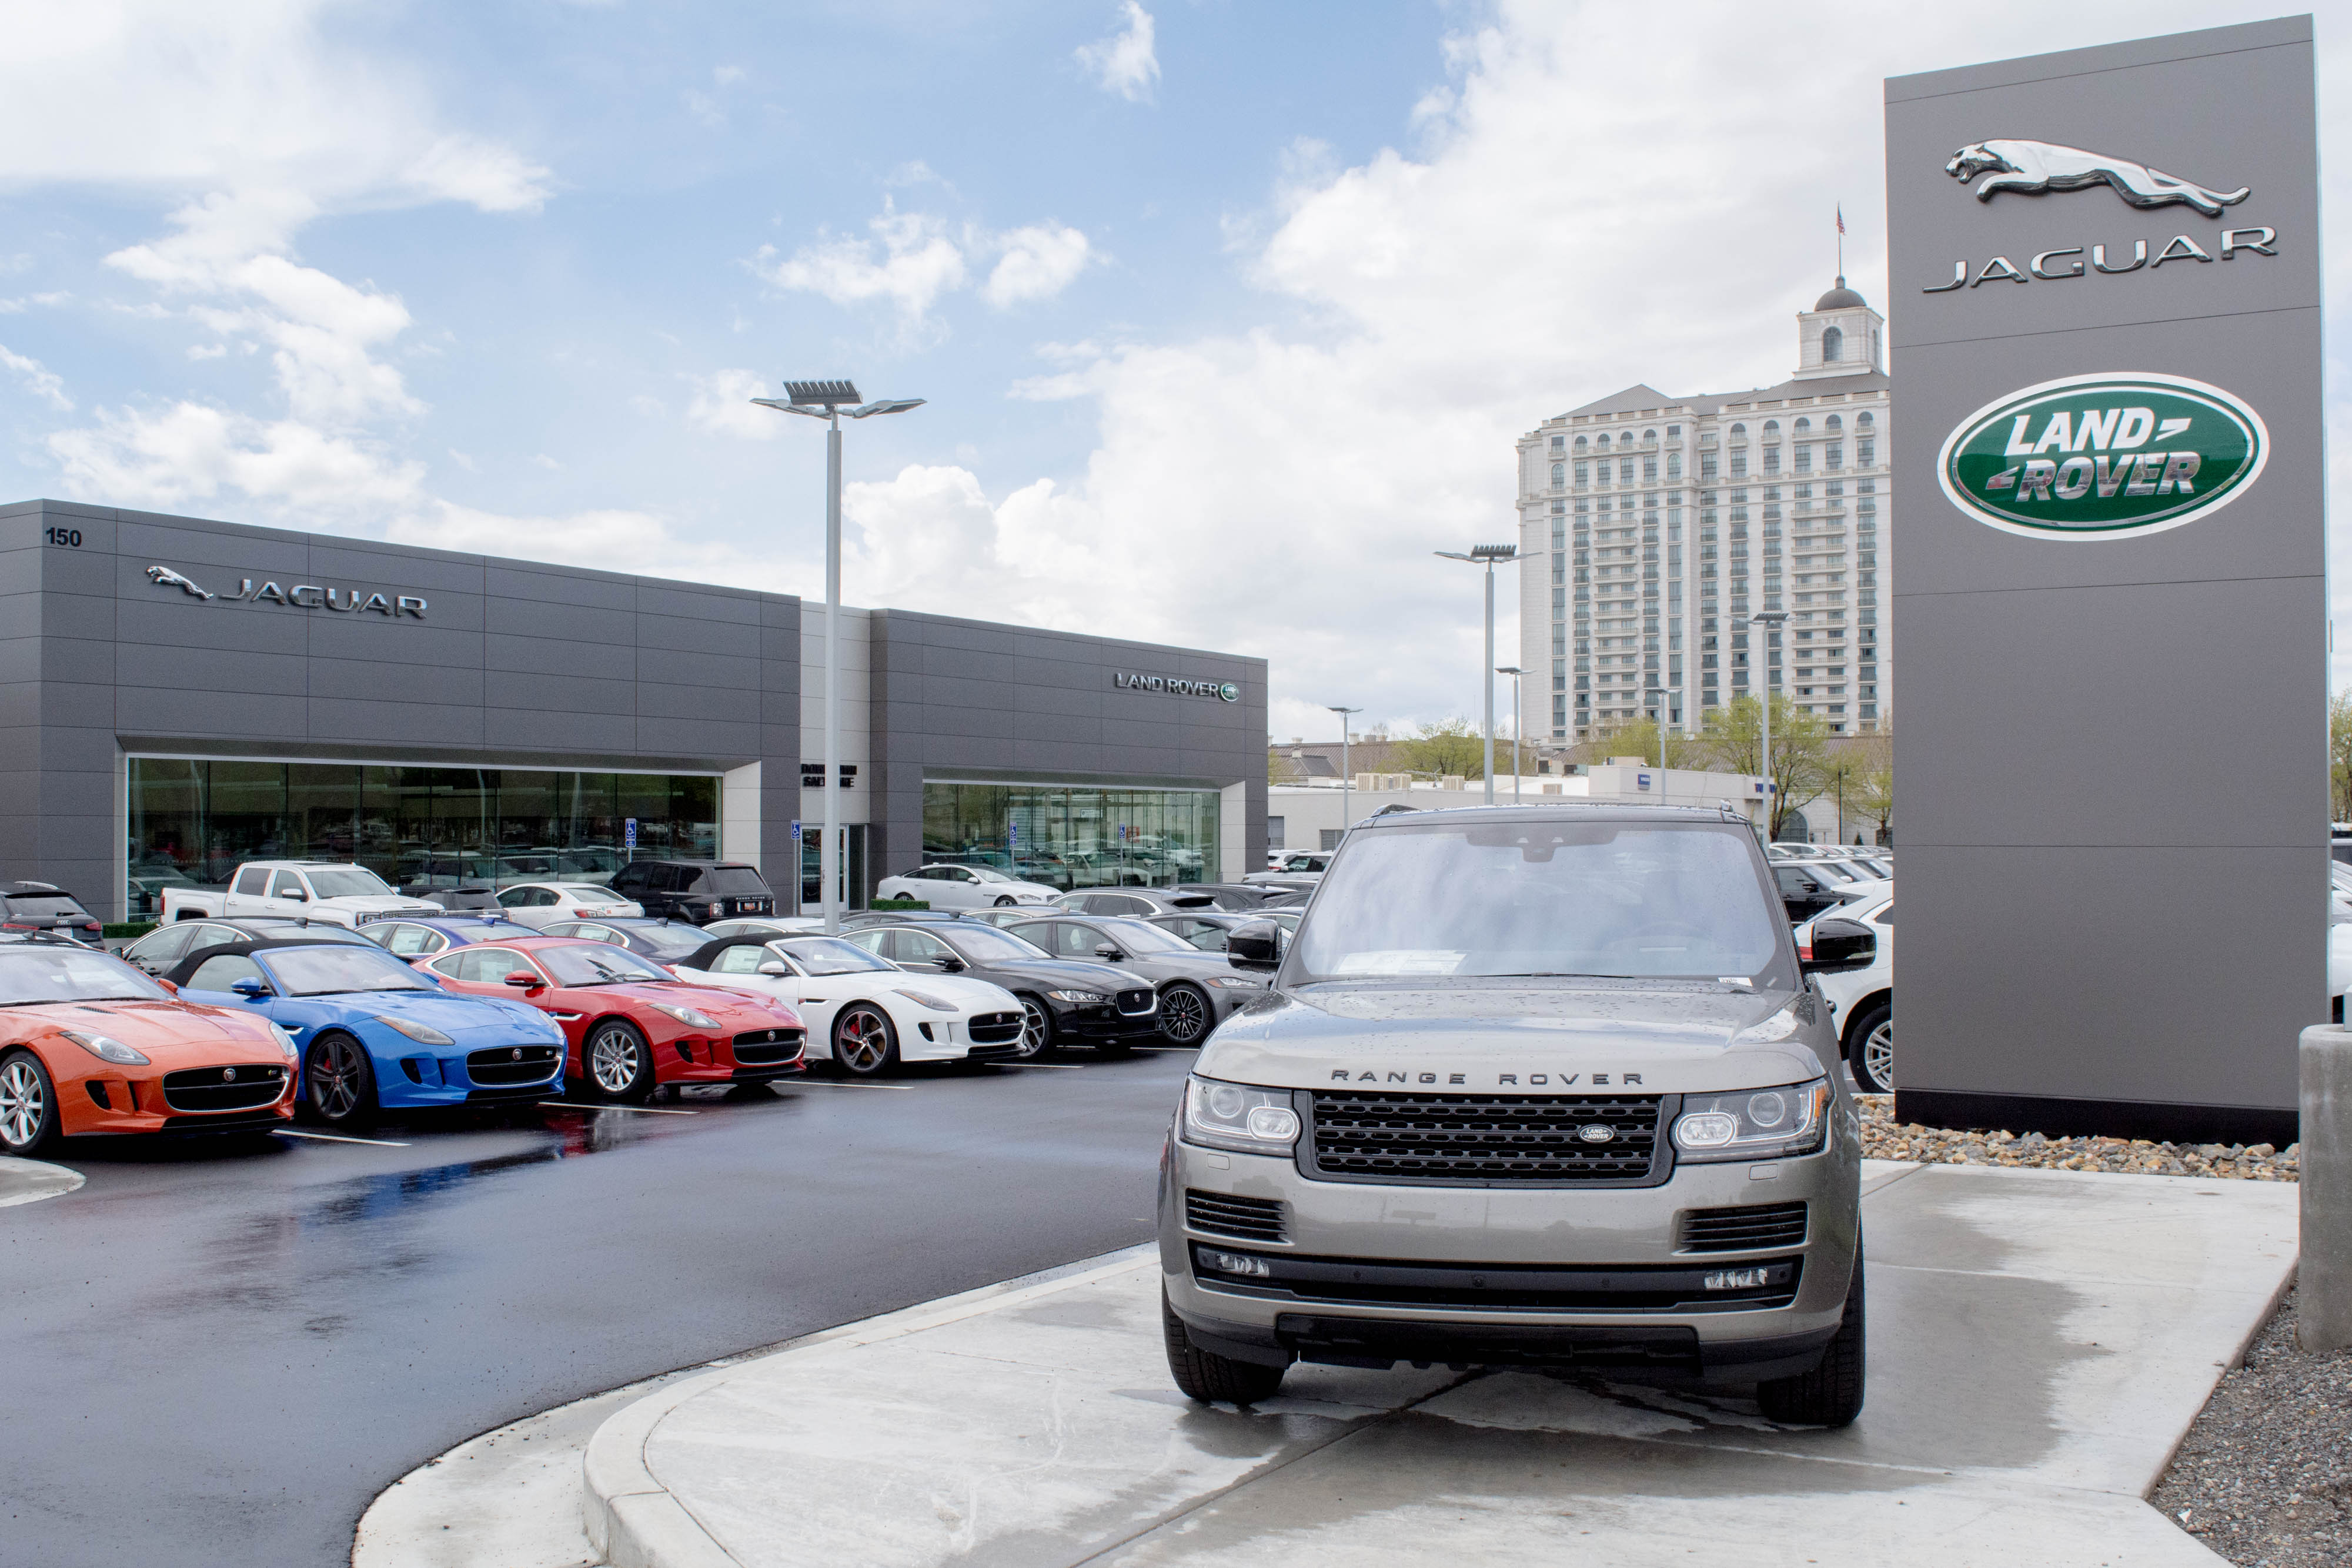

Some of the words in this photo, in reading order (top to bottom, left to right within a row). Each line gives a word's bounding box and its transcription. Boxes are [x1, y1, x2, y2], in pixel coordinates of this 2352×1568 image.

[1922, 225, 2278, 293] JAGUAR
[2003, 406, 2155, 457] LAND
[2015, 452, 2201, 502] ROVER
[46, 527, 82, 547] 150
[218, 579, 427, 619] JAGUAR
[1117, 673, 1162, 691] LAND
[1167, 678, 1218, 697] ROVER
[1331, 1069, 1466, 1085] RANGE
[1498, 1072, 1643, 1085] ROVER
